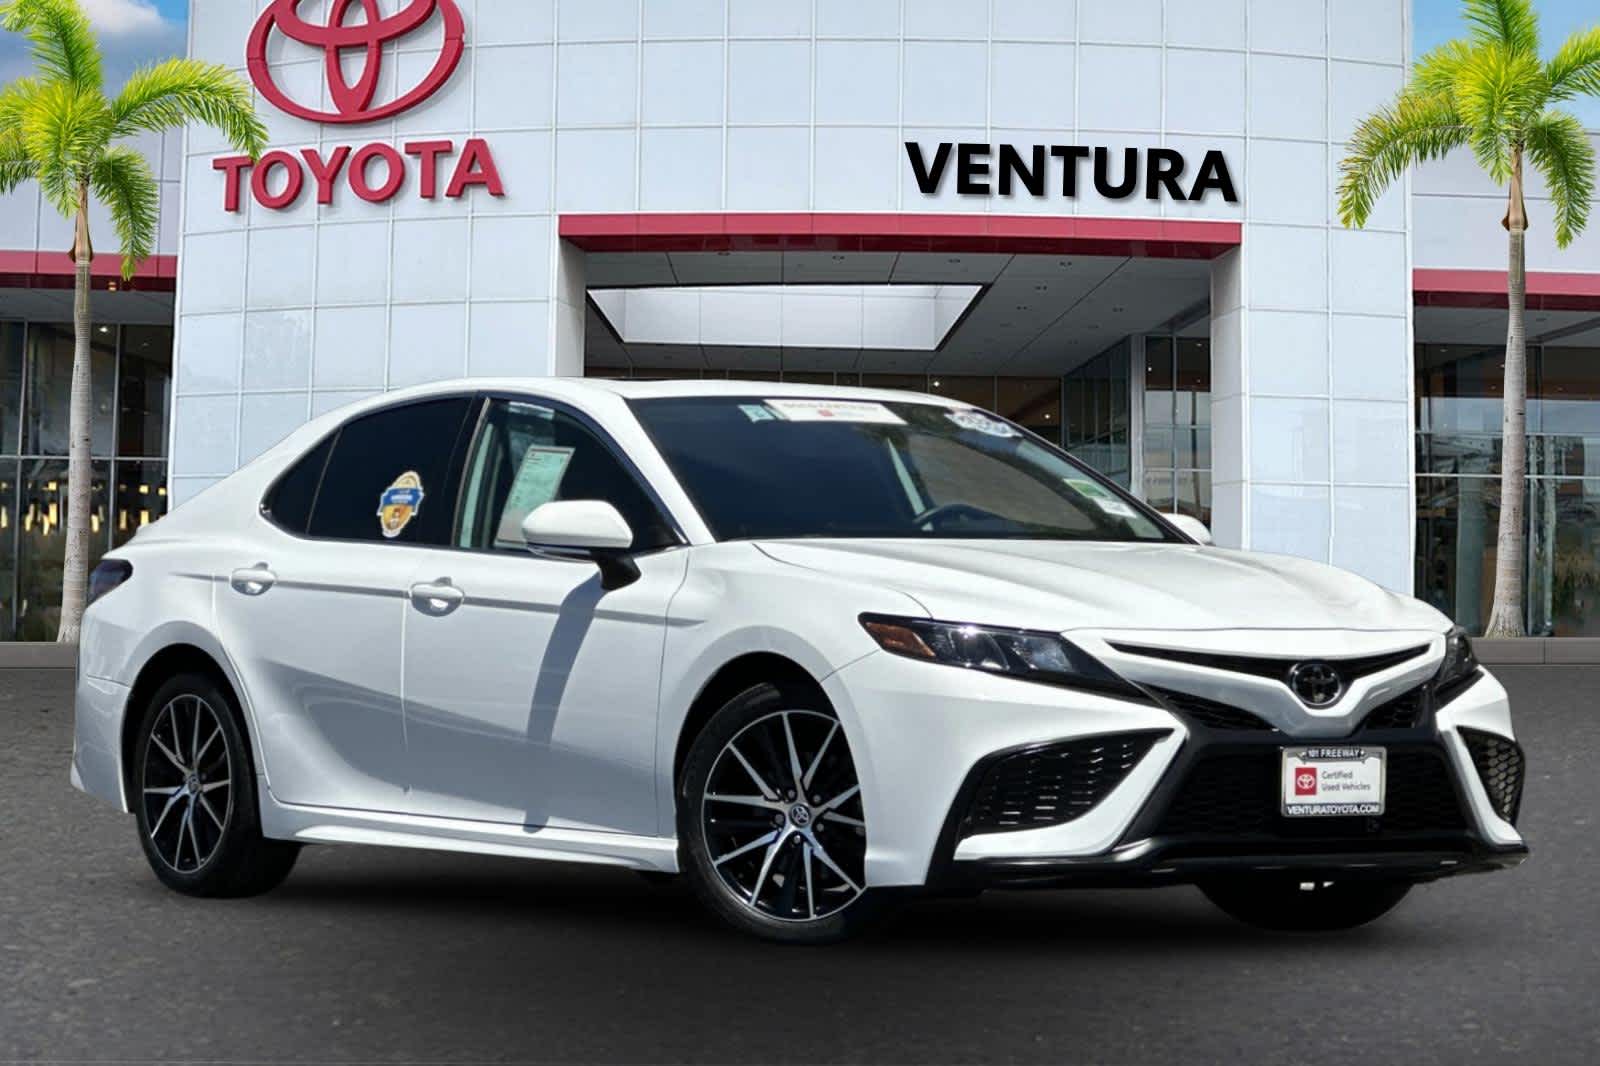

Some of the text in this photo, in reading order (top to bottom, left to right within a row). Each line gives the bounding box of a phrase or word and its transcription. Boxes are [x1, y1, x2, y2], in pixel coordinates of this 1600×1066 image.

[212, 138, 505, 213] TOYOTA
[904, 141, 1238, 203] VENTURA
[1321, 748, 1360, 758] FREEWAY
[1322, 770, 1353, 780] Certified
[1322, 782, 1371, 791] Used Vehicles
[1287, 804, 1379, 815] VENTURATOYOTA.COM
